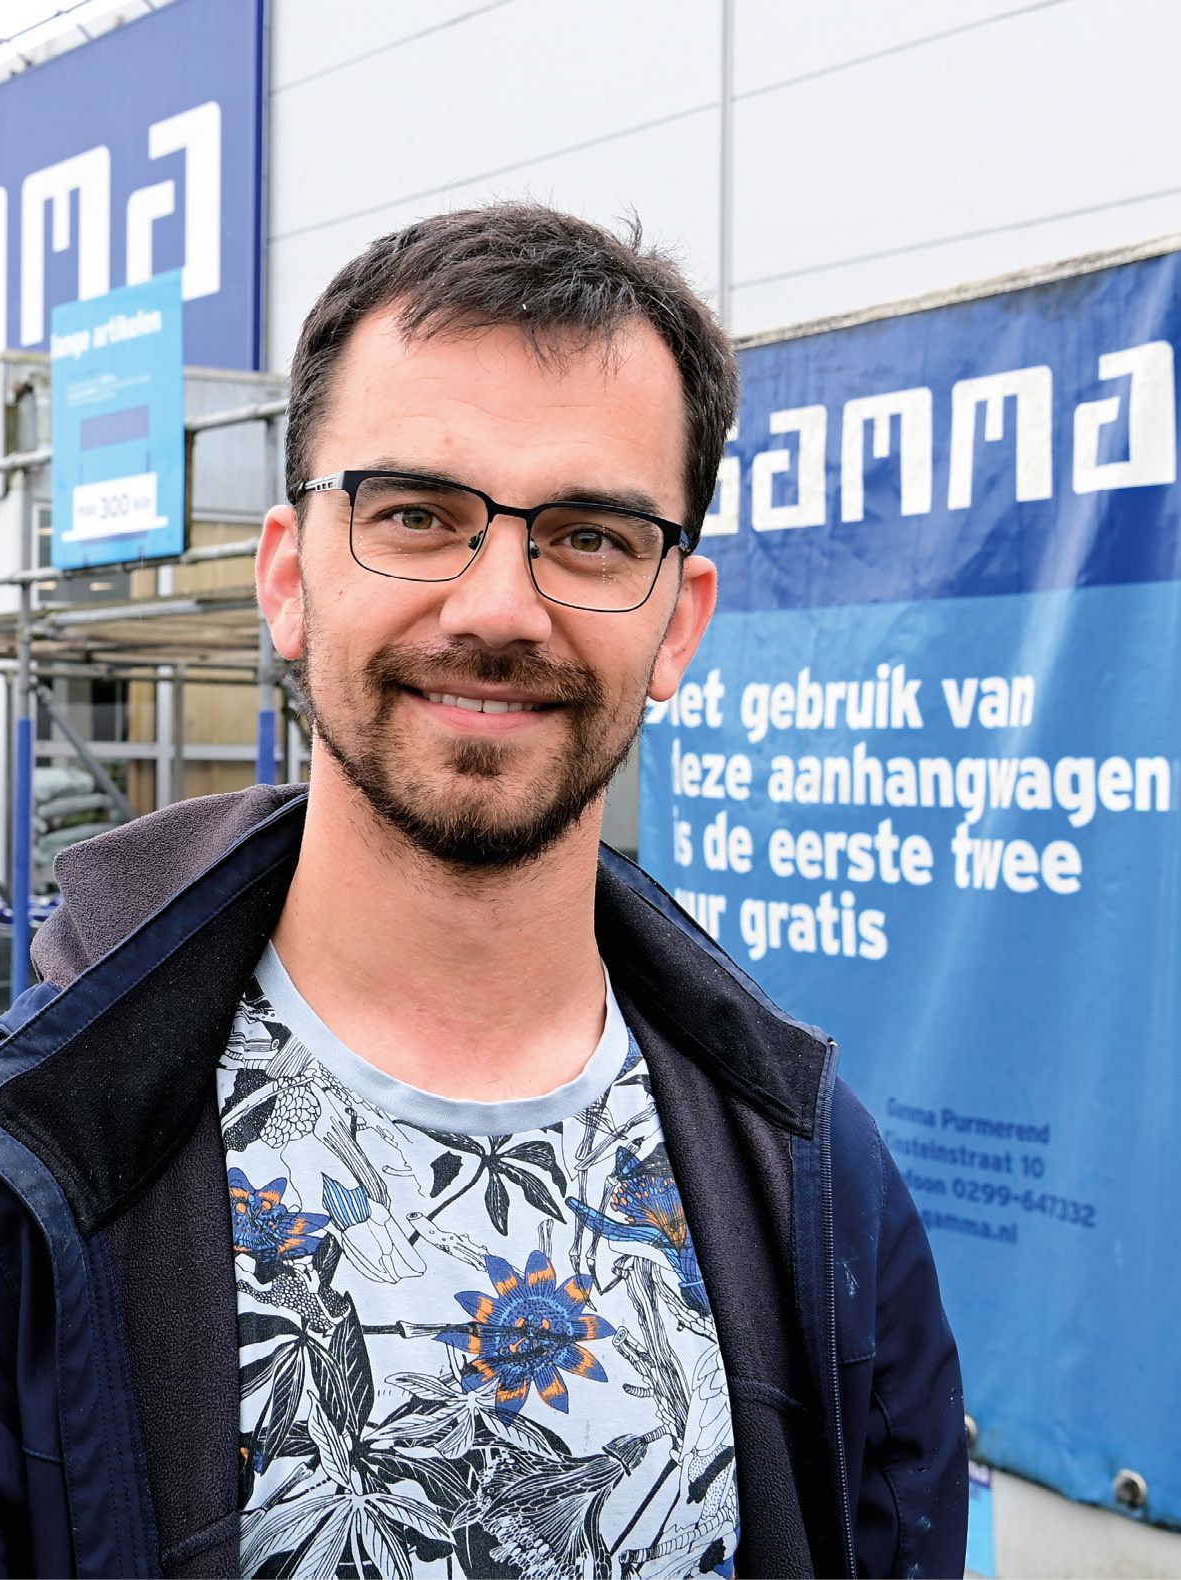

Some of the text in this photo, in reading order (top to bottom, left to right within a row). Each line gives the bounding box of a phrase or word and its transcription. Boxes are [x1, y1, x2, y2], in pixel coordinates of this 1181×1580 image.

[739, 663, 923, 744] gebruik
[941, 674, 1035, 729] van
[767, 740, 1171, 828] aanhangwagen
[673, 804, 1083, 894] is de eerste twee
[739, 889, 888, 960] gratis
[941, 1107, 1050, 1144] Purmerend
[1021, 1156, 1044, 1179] 10
[920, 1208, 1017, 1244] gamma.nl
